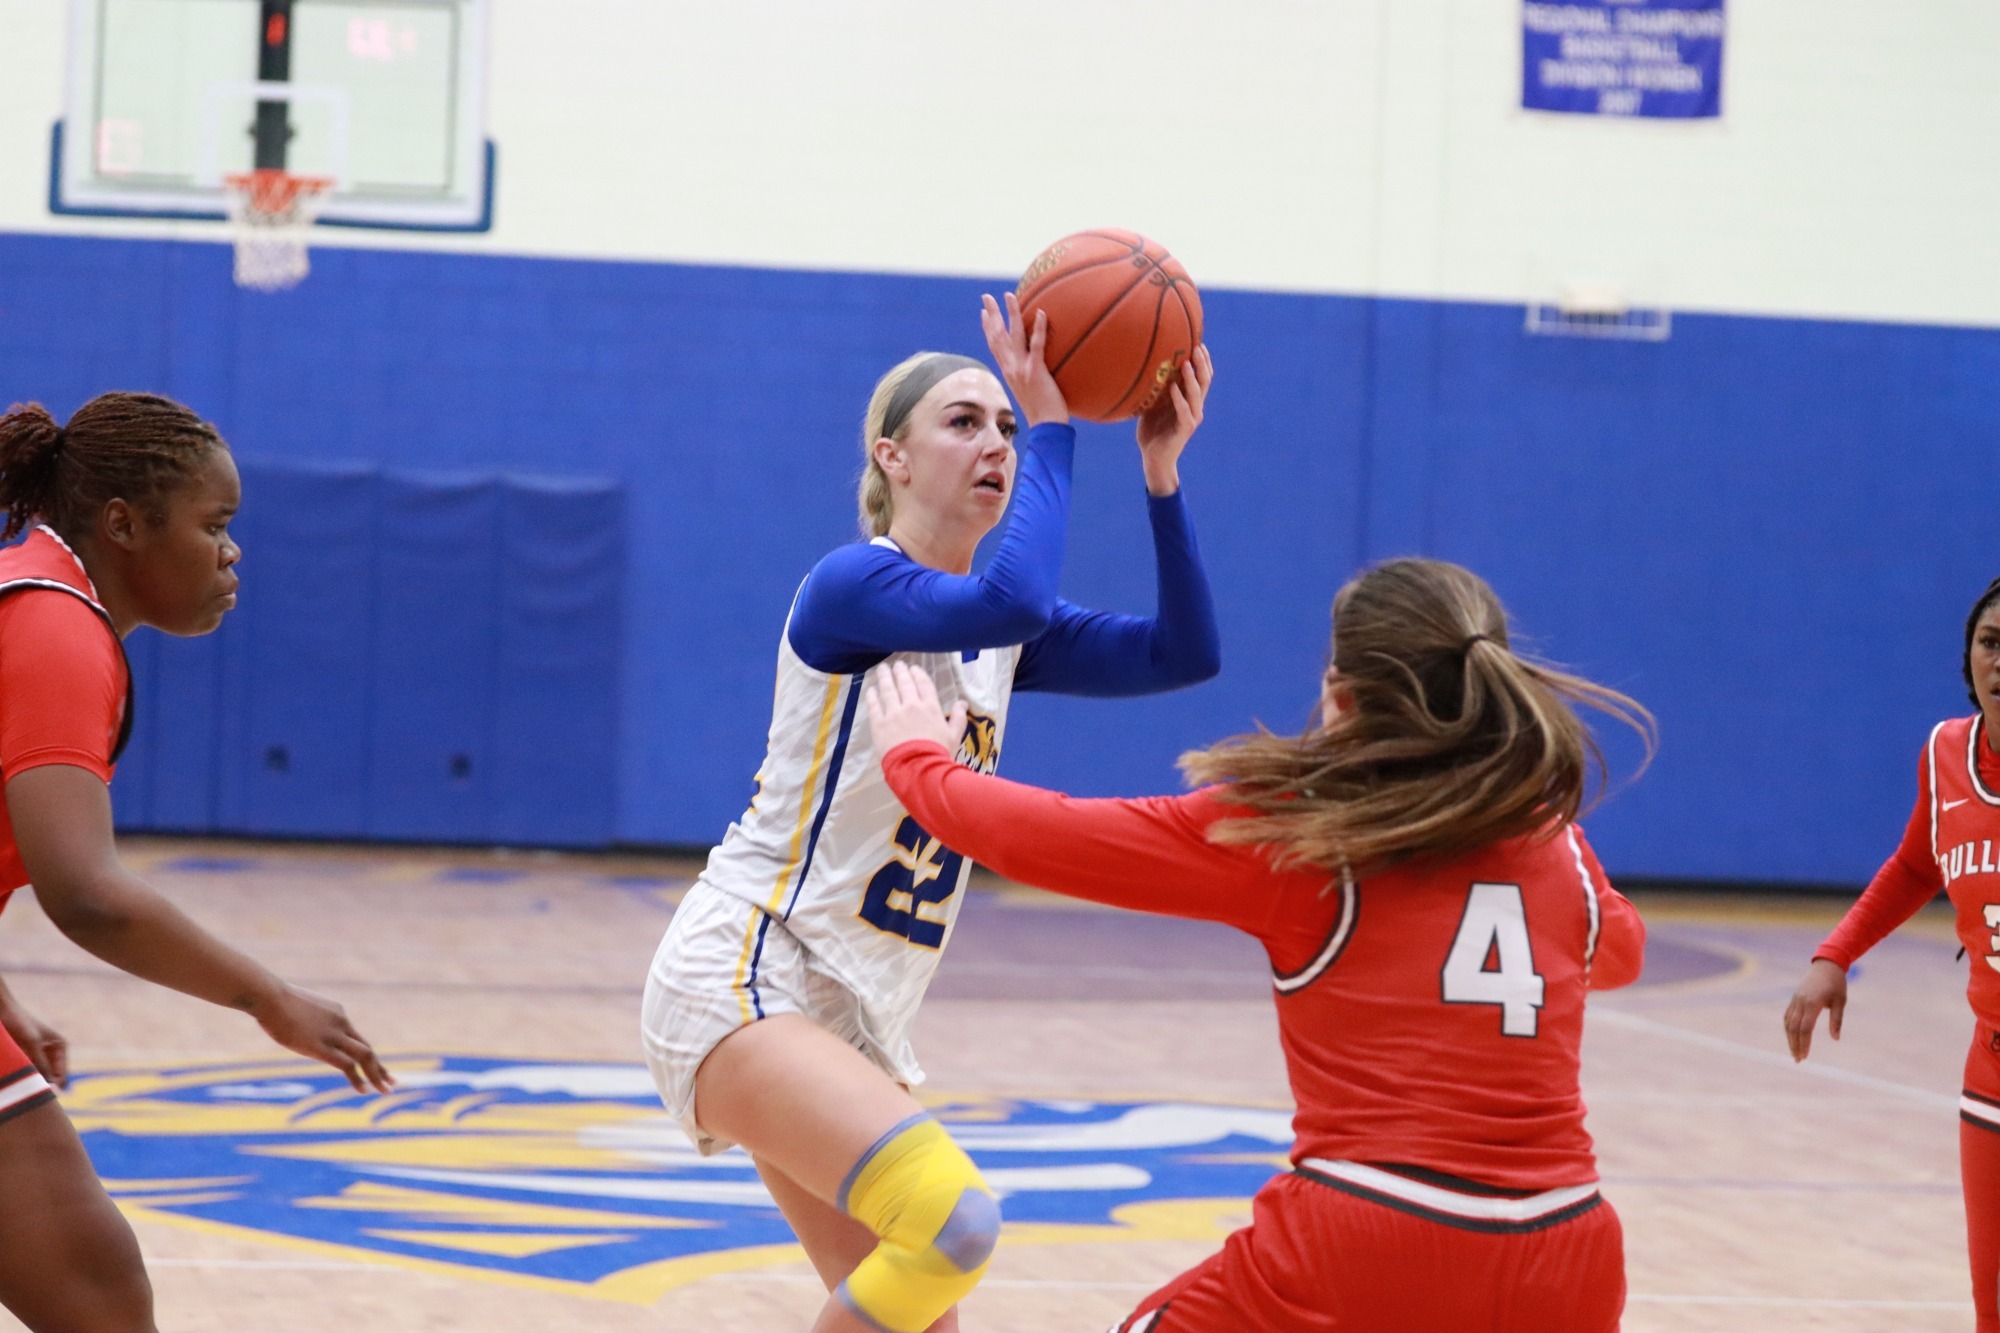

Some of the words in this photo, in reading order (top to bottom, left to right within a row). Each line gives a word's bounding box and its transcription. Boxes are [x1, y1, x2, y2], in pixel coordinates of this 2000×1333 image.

[855, 813, 966, 951] 22
[1939, 839, 2000, 888] BULL
[1440, 881, 1545, 1039] 4
